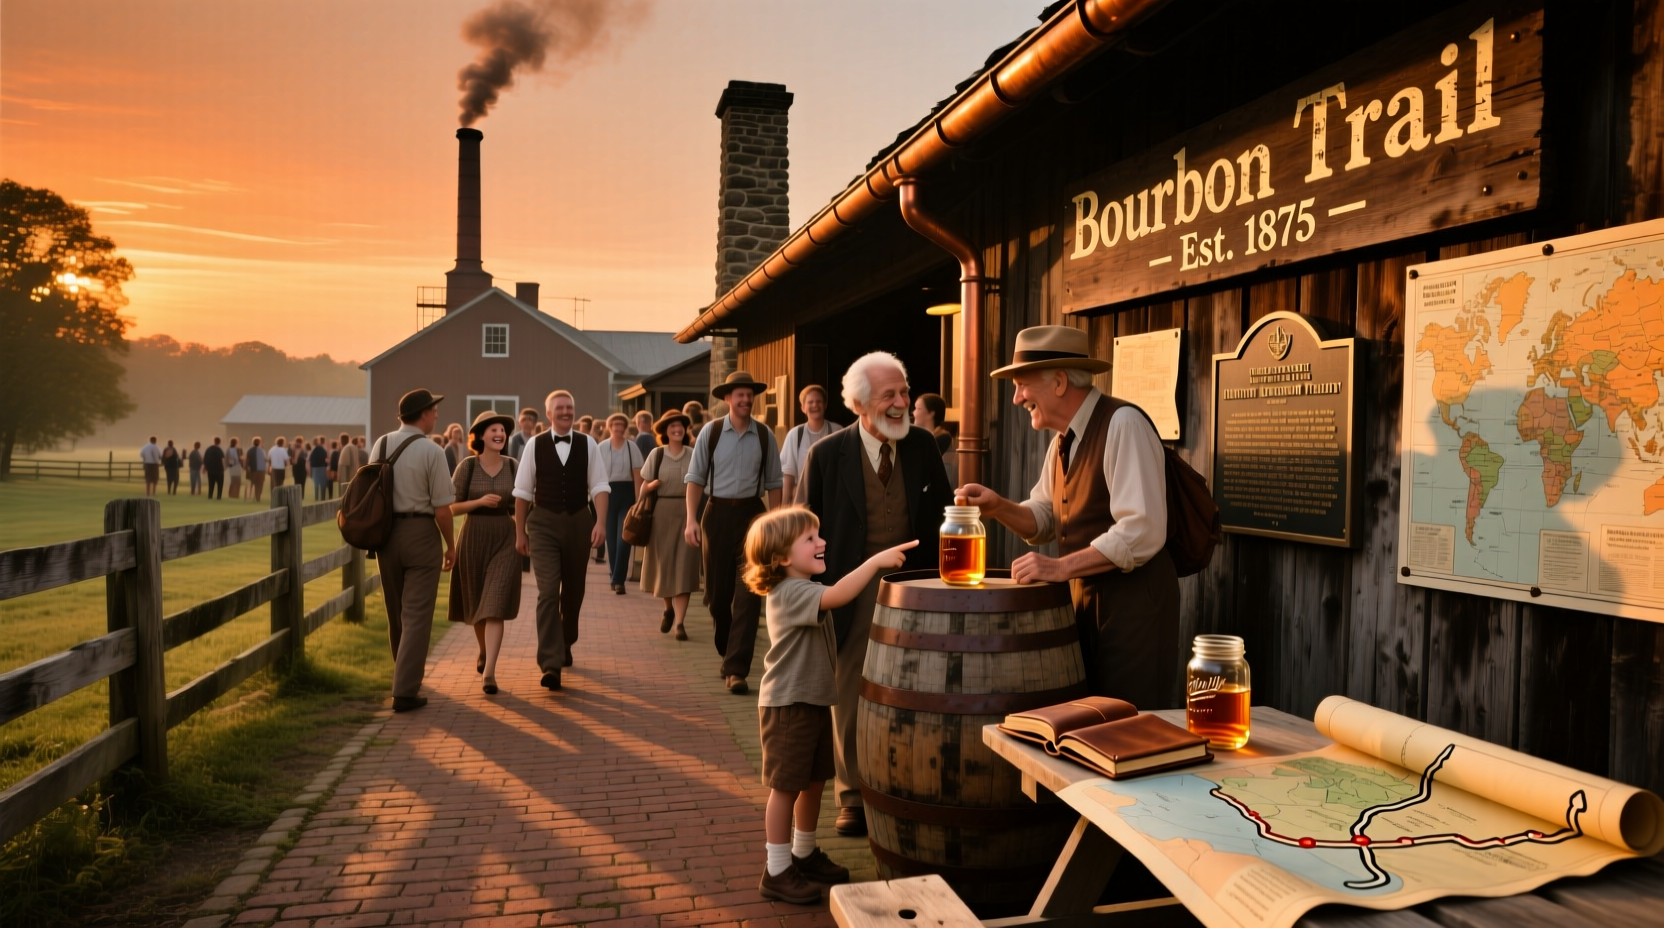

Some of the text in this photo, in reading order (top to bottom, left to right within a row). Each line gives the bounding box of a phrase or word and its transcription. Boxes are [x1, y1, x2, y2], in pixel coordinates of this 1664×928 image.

[1070, 17, 1501, 260] Bourbon Trail
[1179, 197, 1316, 272] Est. 1875
